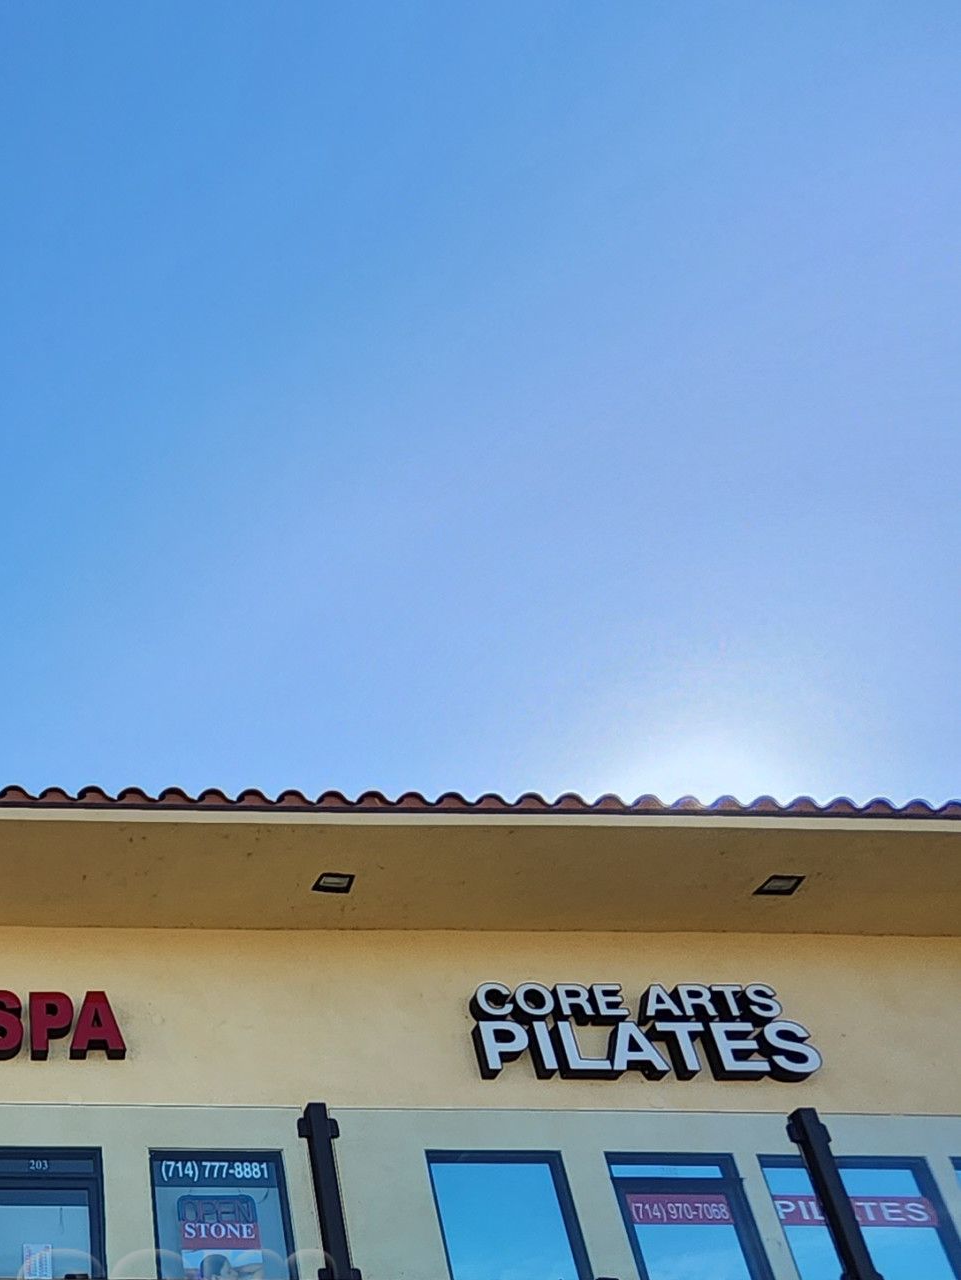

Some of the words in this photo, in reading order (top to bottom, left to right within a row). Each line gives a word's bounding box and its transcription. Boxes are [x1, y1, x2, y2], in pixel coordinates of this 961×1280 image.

[471, 982, 630, 1020] CORE
[643, 983, 783, 1021] ARTS
[472, 1019, 824, 1081] PILATES
[29, 1159, 49, 1172] 203
[161, 1160, 200, 1182] (714)
[203, 1161, 269, 1180] 777-8881
[182, 1199, 255, 1223] OPEN
[632, 1202, 667, 1223] (714)
[669, 1202, 730, 1221] 970-7068
[777, 1200, 931, 1222] PILTES
[184, 1222, 256, 1239] STONE
